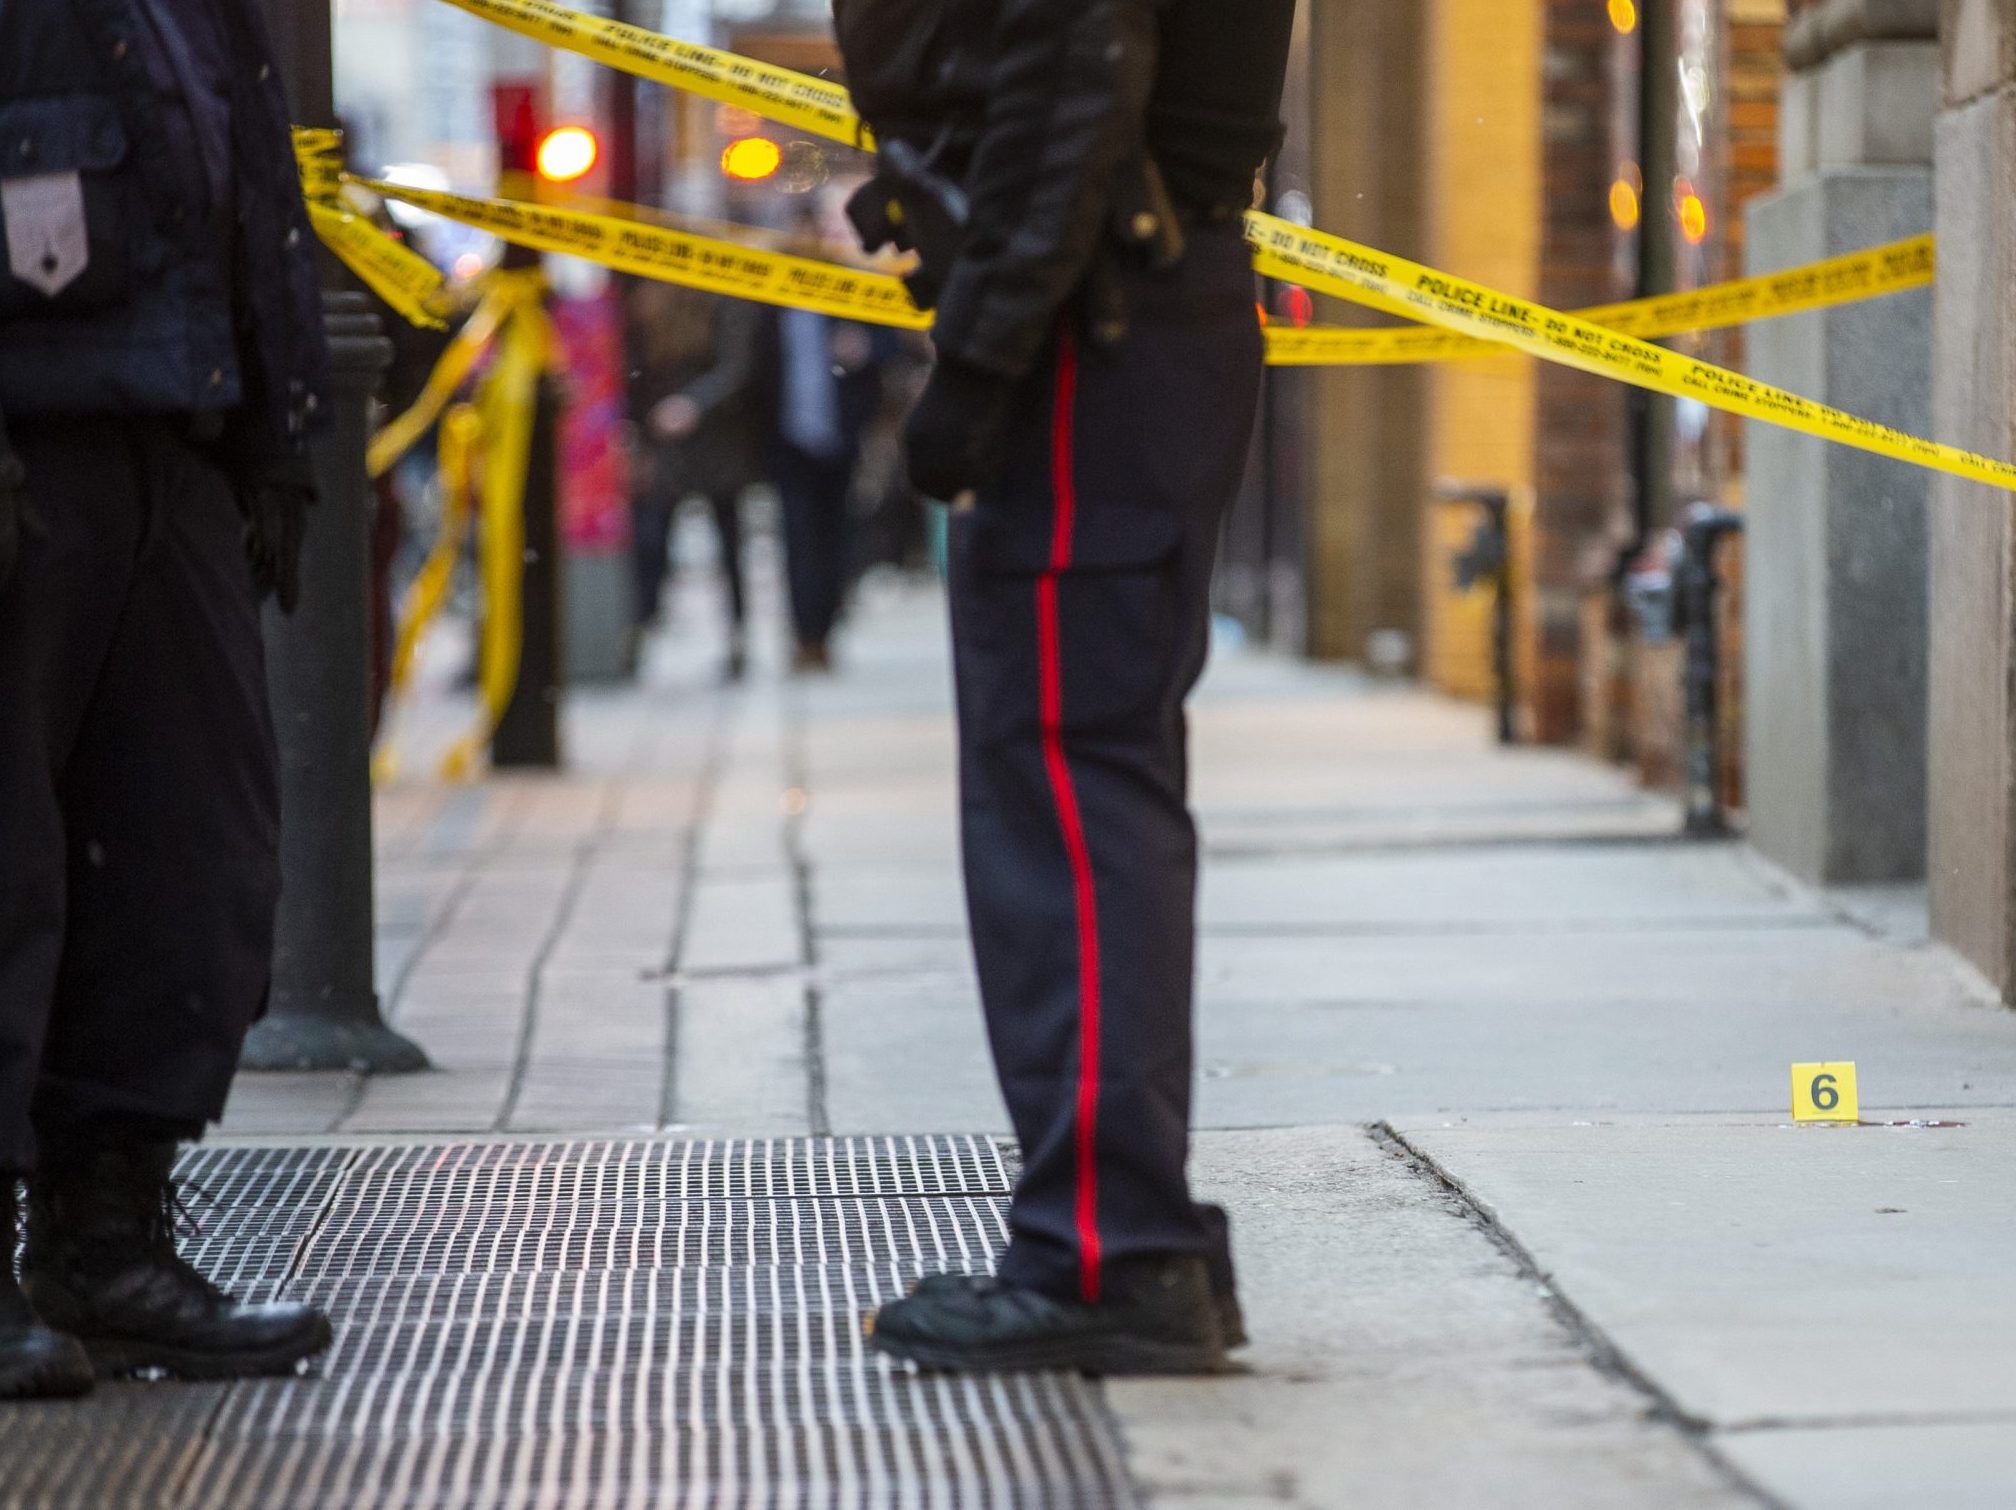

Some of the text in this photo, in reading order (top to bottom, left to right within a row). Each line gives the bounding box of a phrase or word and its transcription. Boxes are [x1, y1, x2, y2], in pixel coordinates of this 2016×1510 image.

[1334, 249, 1389, 277] CROSS
[1417, 273, 1484, 307] POLICE
[1545, 319, 1567, 334] DO
[1573, 328, 1603, 345] NOT
[1610, 340, 1663, 363] CROSS
[1692, 364, 1757, 393] POLICE
[1682, 374, 1708, 390] CALL
[1713, 384, 1750, 401] CRIME
[1959, 454, 1987, 470] CALL
[1811, 1074, 1839, 1110] 6
